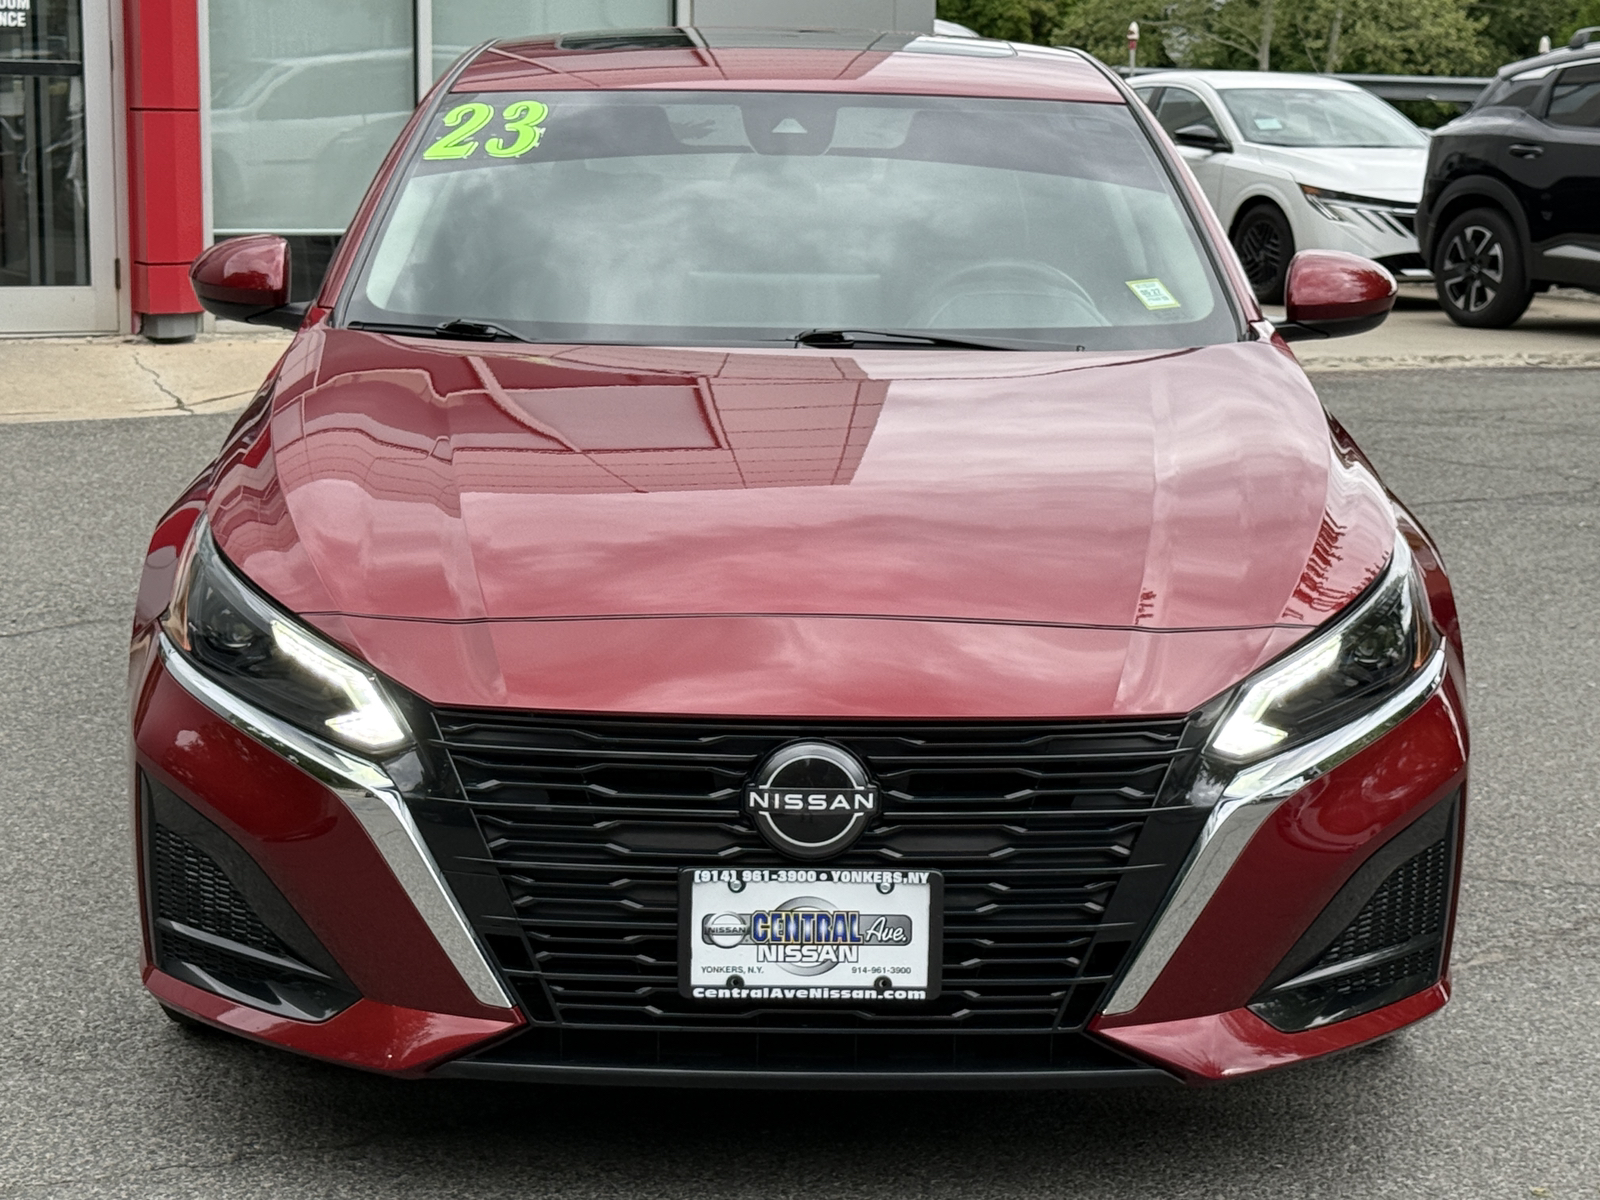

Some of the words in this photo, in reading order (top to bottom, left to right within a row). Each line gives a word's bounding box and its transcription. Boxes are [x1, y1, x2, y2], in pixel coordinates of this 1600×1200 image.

[423, 100, 548, 160] 23
[749, 791, 874, 810] NISSAN
[742, 870, 817, 882] 961-3900
[708, 926, 746, 934] NISSAN
[751, 910, 864, 944] CENTRAL
[865, 915, 907, 942] Ave.
[756, 944, 859, 963] NISSAN
[701, 966, 746, 974] YONKERS,
[747, 966, 764, 974] N.Y.
[851, 966, 912, 974] 914-961-3900
[692, 987, 927, 1000] CentralAveNissan.com
